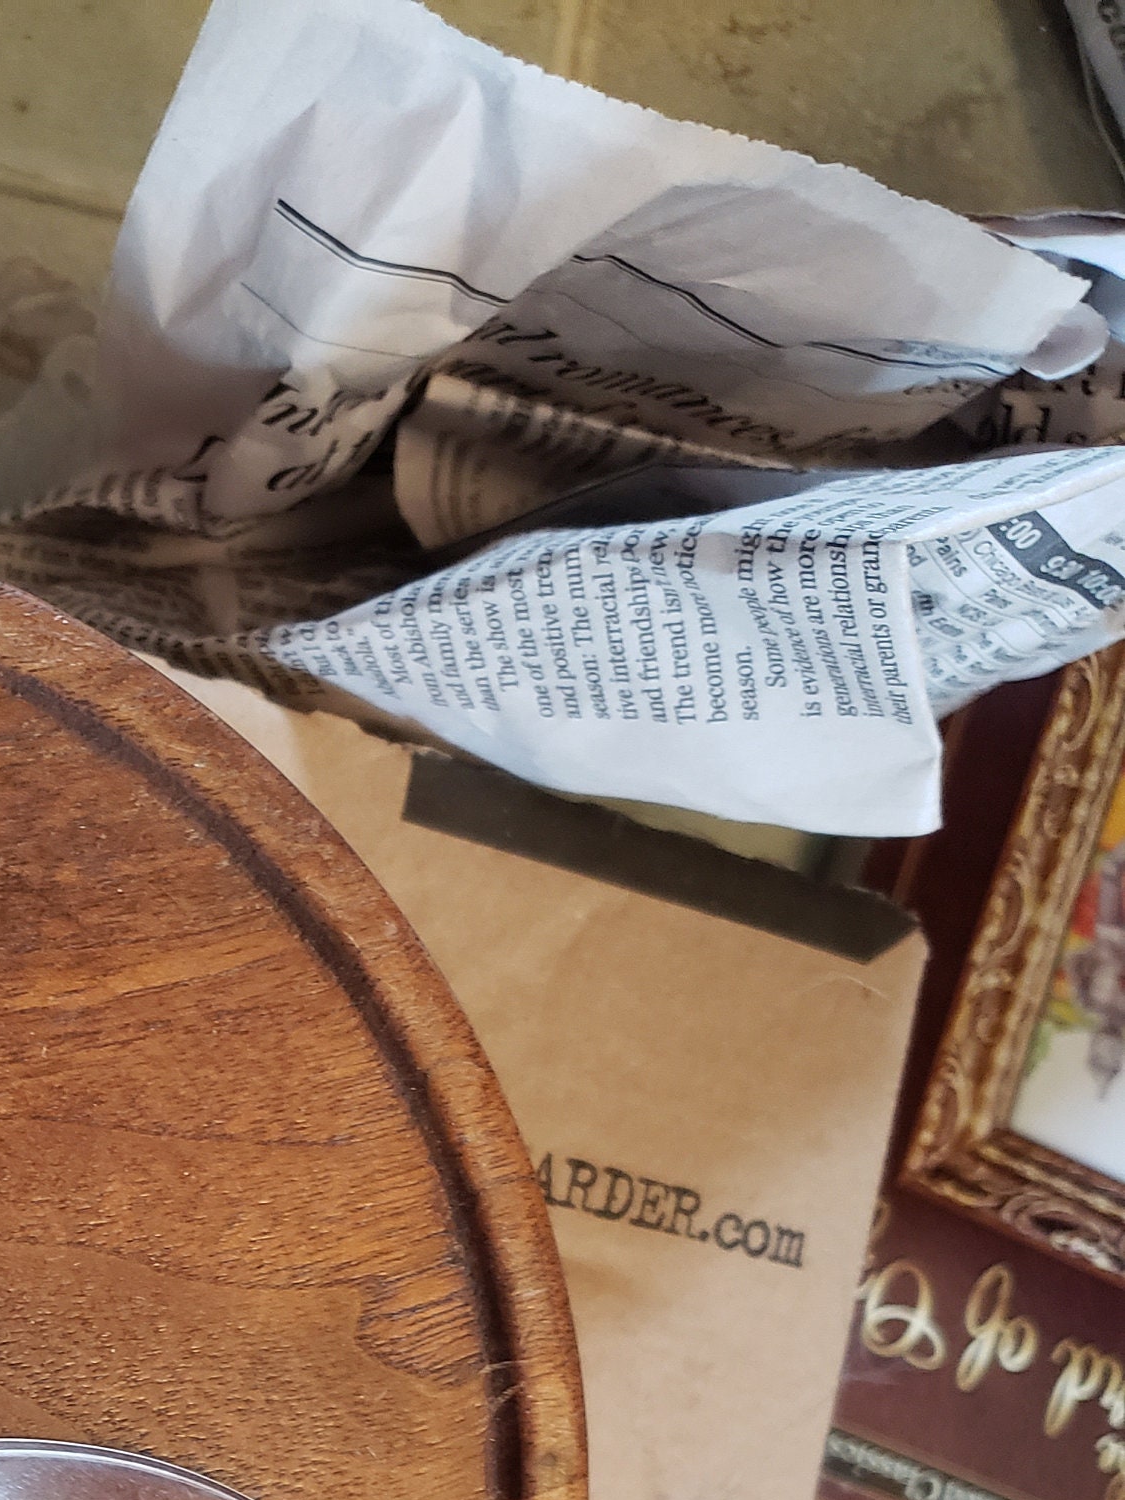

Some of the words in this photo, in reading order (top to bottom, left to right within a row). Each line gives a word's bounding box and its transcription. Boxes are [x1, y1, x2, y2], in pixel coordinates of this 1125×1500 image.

[765, 521, 800, 554] the
[797, 529, 822, 589] more
[506, 568, 530, 622] most
[766, 561, 790, 606] how
[482, 601, 506, 650] show
[572, 606, 594, 647] The
[591, 573, 629, 683] interracial
[625, 566, 660, 681] friendships
[691, 592, 718, 635] more
[737, 587, 778, 636] people
[769, 608, 796, 625] of
[802, 595, 825, 625] are
[866, 598, 887, 619] or
[429, 620, 460, 678] family
[464, 640, 485, 670] the
[514, 628, 538, 657] the
[541, 604, 577, 679] positive
[662, 620, 691, 678] trend
[761, 638, 788, 688] Some
[783, 627, 820, 695] evidence
[870, 624, 907, 687] parents
[384, 645, 412, 683] Most
[496, 655, 519, 691] The
[522, 662, 544, 681] of
[703, 642, 728, 723] become
[735, 646, 759, 721] season.
[810, 629, 858, 716] generations
[840, 642, 885, 717] interracial
[535, 686, 555, 718] one
[556, 686, 582, 719] and
[581, 653, 610, 720] season:
[616, 689, 639, 720] tive
[642, 688, 668, 723] and
[673, 685, 697, 724] The
[883, 690, 913, 725] their
[800, 701, 822, 717] is
